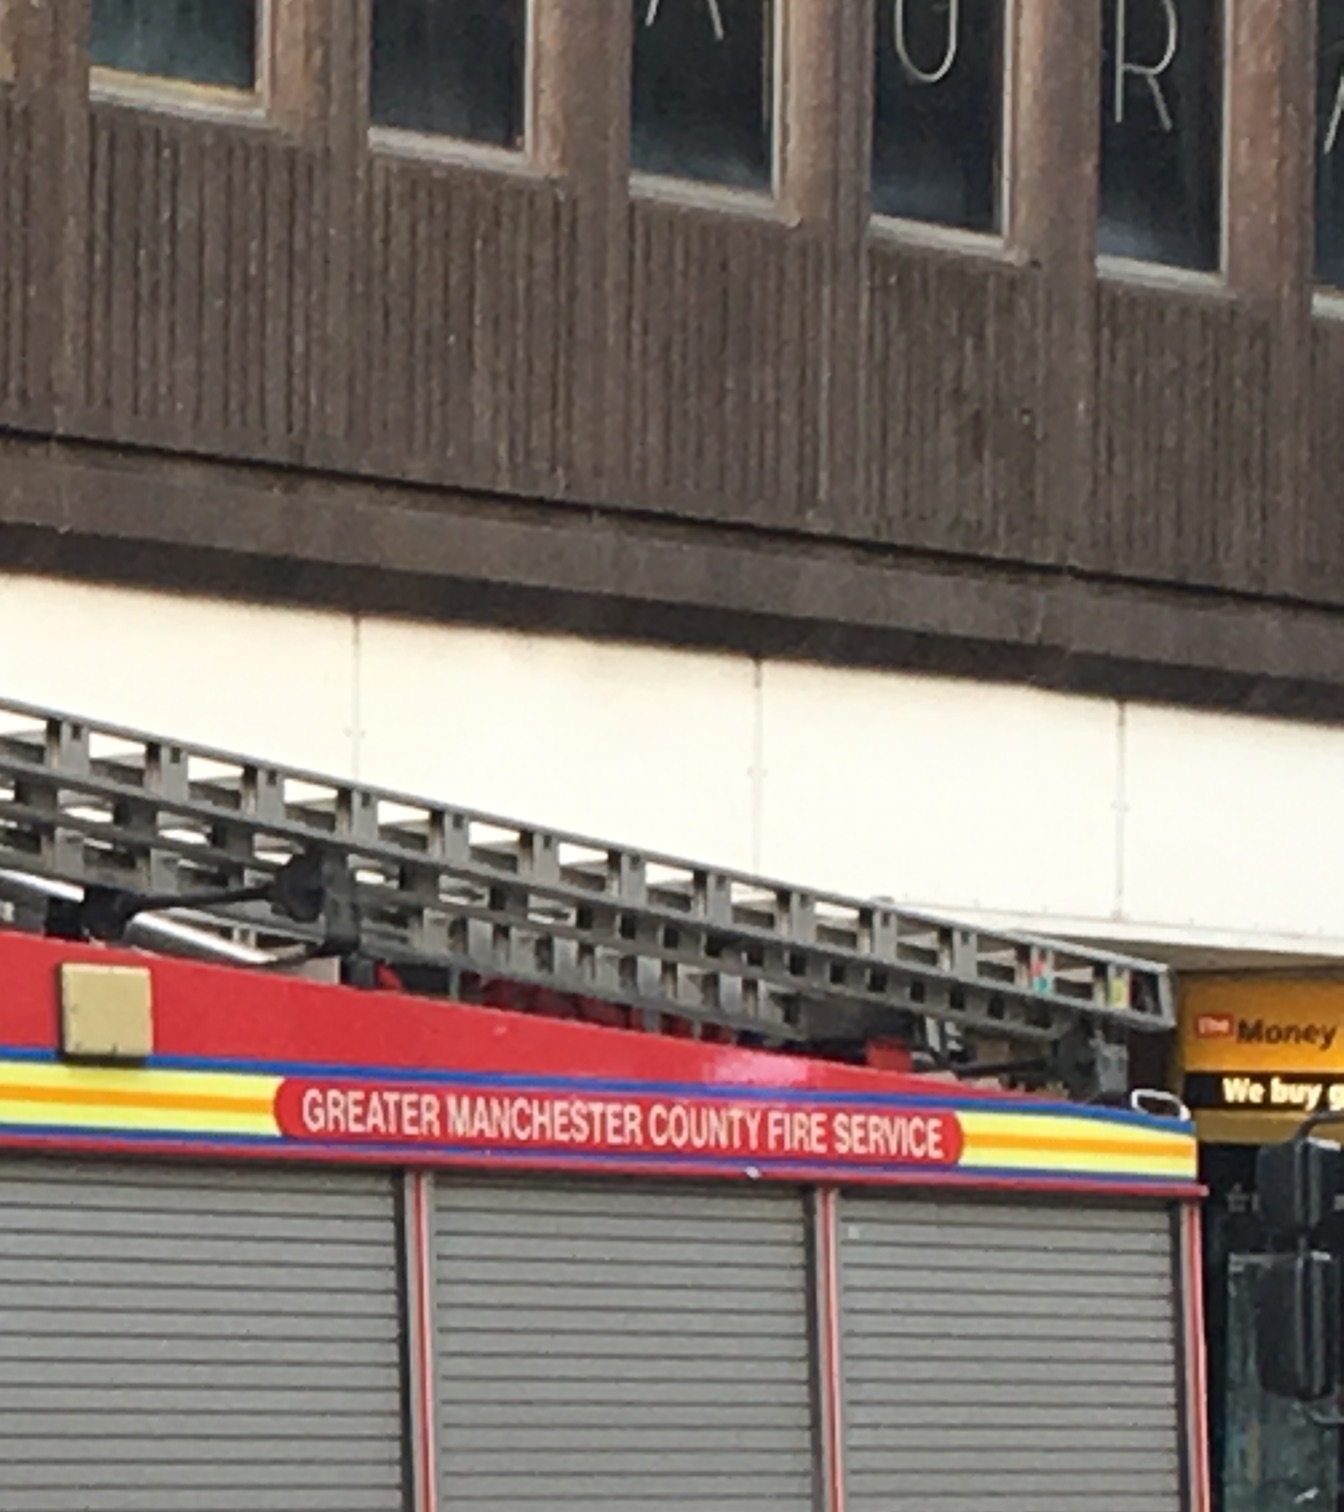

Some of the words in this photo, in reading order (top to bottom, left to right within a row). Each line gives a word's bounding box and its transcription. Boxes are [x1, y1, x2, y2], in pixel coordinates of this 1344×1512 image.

[1238, 1018, 1337, 1051] Money
[1222, 1077, 1265, 1103] We
[1270, 1076, 1322, 1111] buy
[302, 1089, 440, 1136] GREATER
[447, 1095, 643, 1145] MANCHESTER
[649, 1104, 763, 1150] COUNTY
[768, 1110, 828, 1154] FIRE
[833, 1114, 946, 1159] SERVICE
